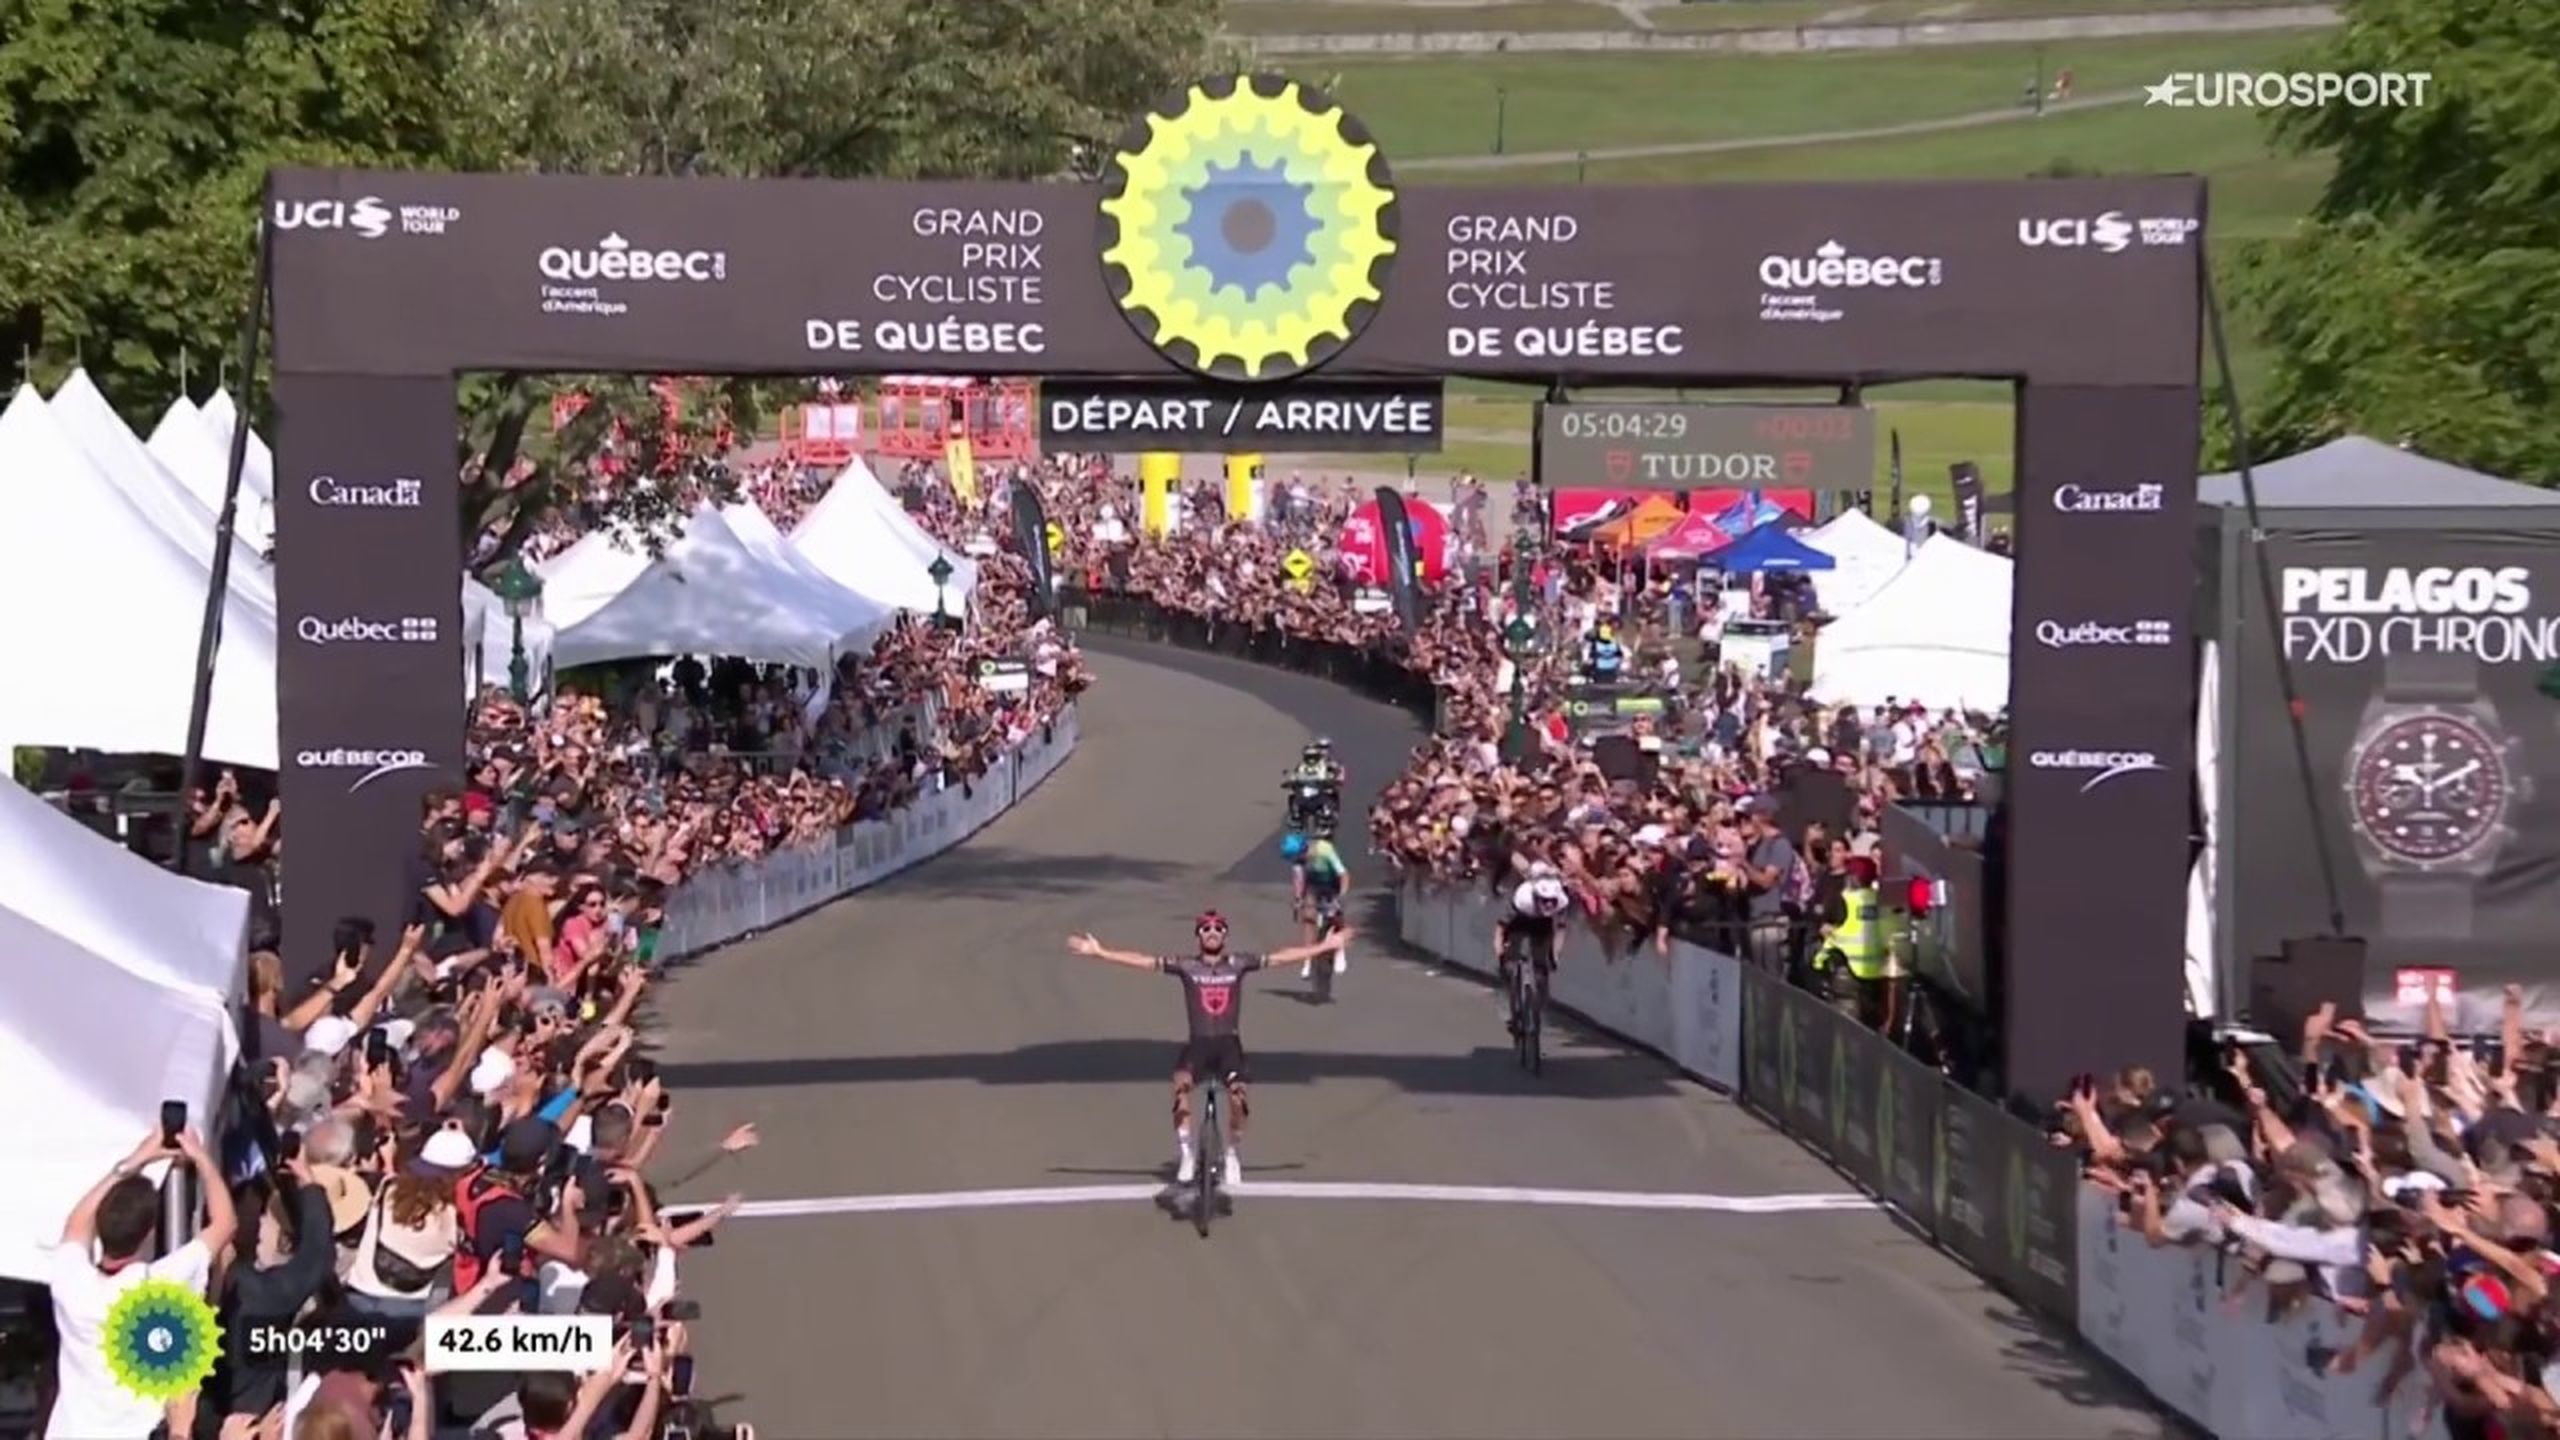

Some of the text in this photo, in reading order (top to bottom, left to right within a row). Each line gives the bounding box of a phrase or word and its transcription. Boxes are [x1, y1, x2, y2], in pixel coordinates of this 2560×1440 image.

[275, 200, 344, 229] UCI
[400, 206, 460, 221] WORLD
[402, 220, 445, 234] TOUR
[913, 208, 1043, 237] GRAND
[2138, 218, 2198, 233] WORLD
[1447, 215, 1578, 242] GRAND
[2019, 219, 2086, 246] UCI
[2142, 231, 2184, 245] TOUR
[962, 242, 1041, 269] PRIX
[1448, 248, 1526, 275] PRIX
[873, 274, 1041, 304] CYCLISTE
[1447, 282, 1614, 309] CYCLISTE
[806, 315, 1045, 353] DE QUÉBEC
[1448, 319, 1683, 357] DE QUÉBEC
[1052, 396, 1431, 435] DÉPART / ARRIVÉE
[1562, 412, 1688, 438] 05:04:29
[1641, 454, 1778, 480] TUDOR
[309, 476, 421, 506] Canada
[2053, 483, 2163, 512] Canada
[2283, 567, 2530, 613] PELAGOS
[298, 616, 398, 645] Québec
[2036, 620, 2133, 648] Québec
[2284, 616, 2372, 662] FXD
[297, 749, 425, 766] QUÉBECOR
[2031, 751, 2155, 768] QUÉBECOR
